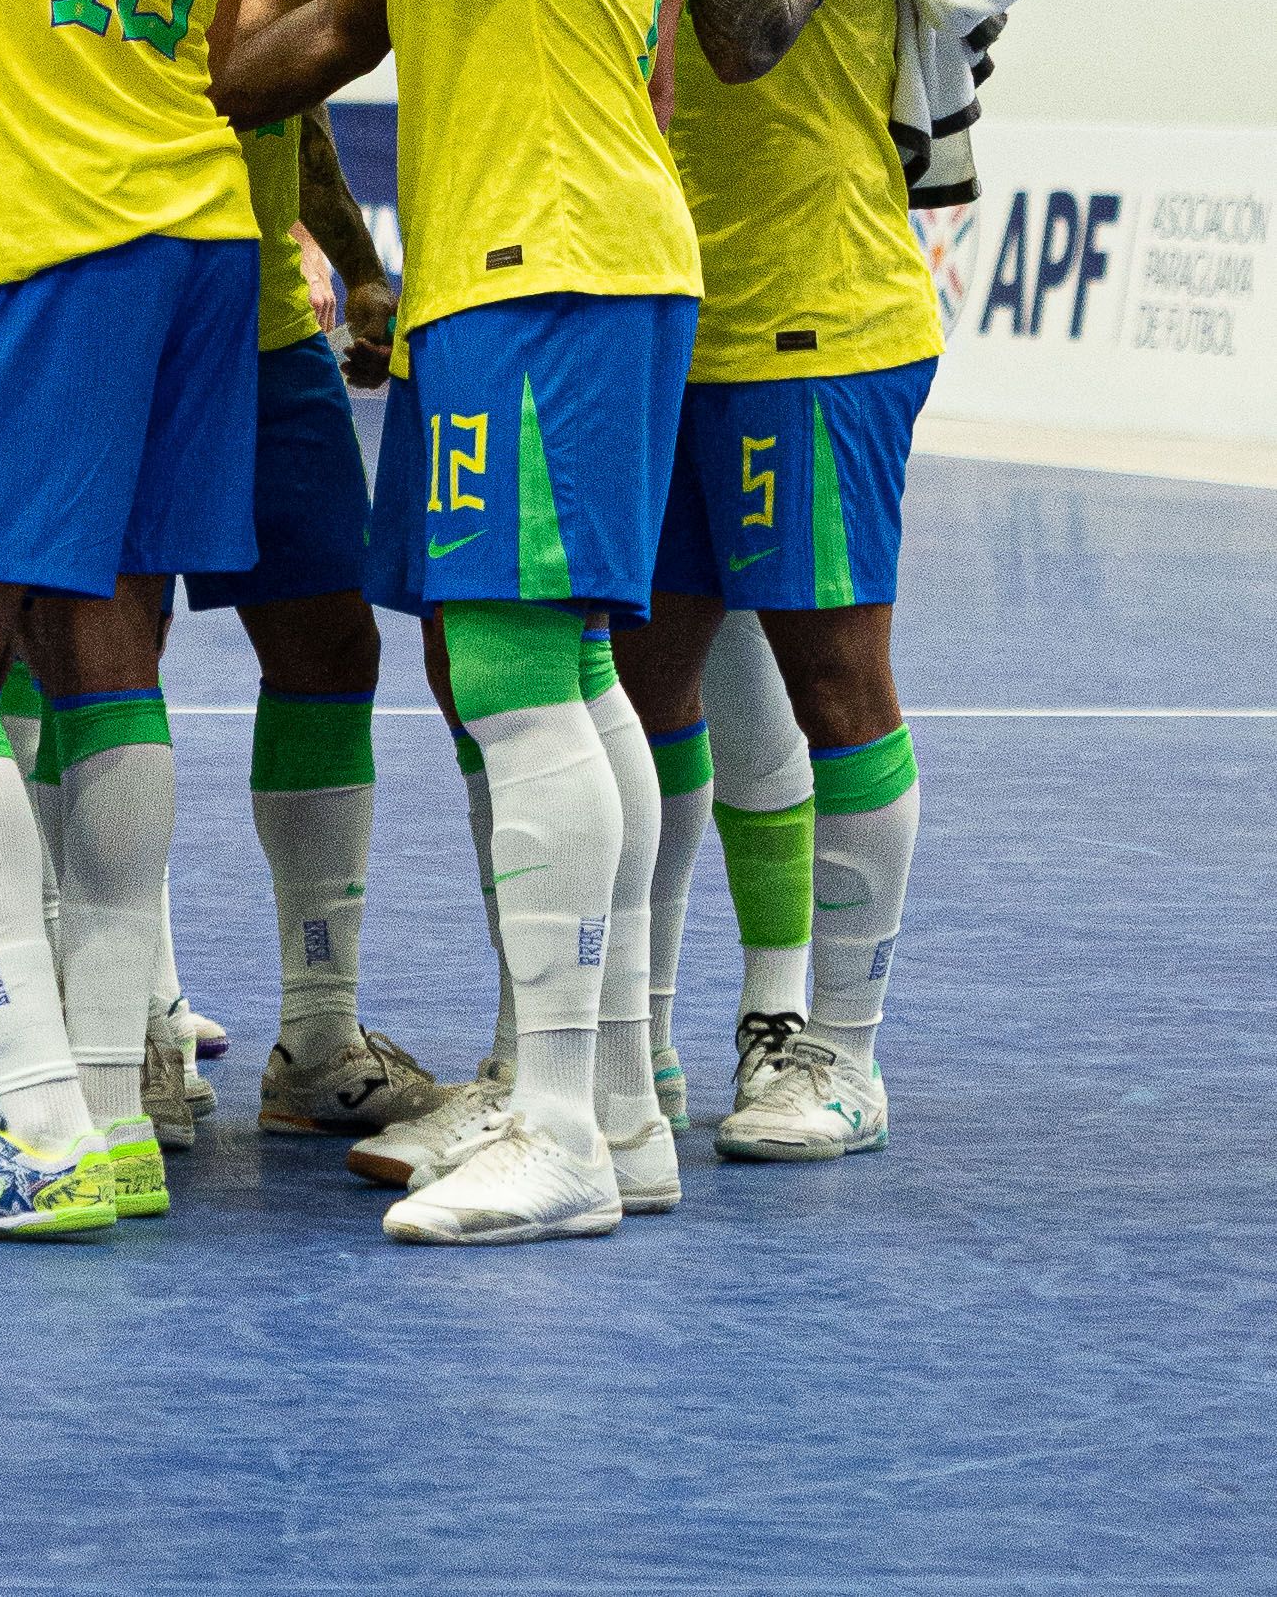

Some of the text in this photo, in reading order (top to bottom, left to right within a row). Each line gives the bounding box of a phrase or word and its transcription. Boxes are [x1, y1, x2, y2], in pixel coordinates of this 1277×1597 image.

[977, 190, 1121, 340] APF
[1144, 247, 1254, 298] PARAGUAYA
[1132, 300, 1162, 349] DE
[426, 413, 489, 513] 12
[742, 434, 776, 529] 5
[578, 914, 607, 967] BRASIL
